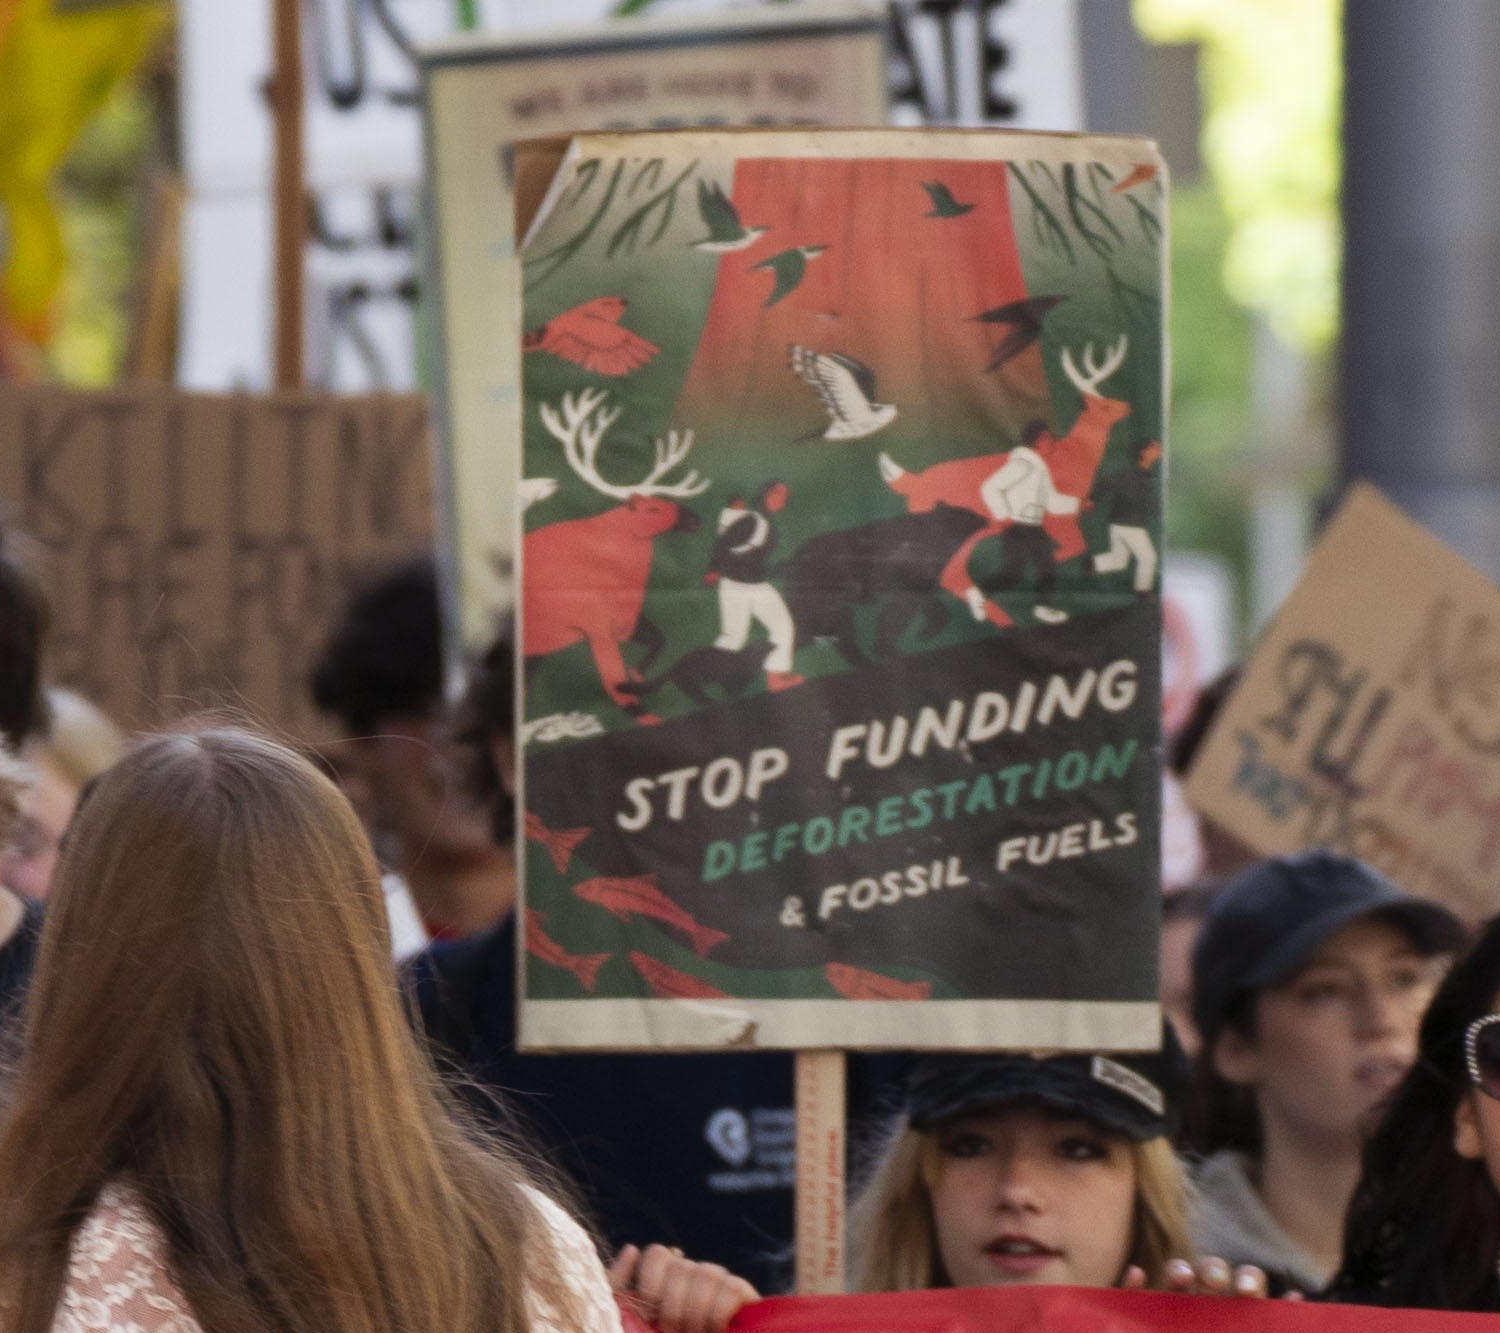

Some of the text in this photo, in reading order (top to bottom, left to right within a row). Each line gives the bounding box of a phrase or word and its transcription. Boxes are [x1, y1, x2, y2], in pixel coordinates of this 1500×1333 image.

[616, 659, 1138, 833] STOP FUNDING
[701, 738, 1138, 883] DEFORESTATION
[779, 812, 1139, 928] & FOSSIL FUELS
